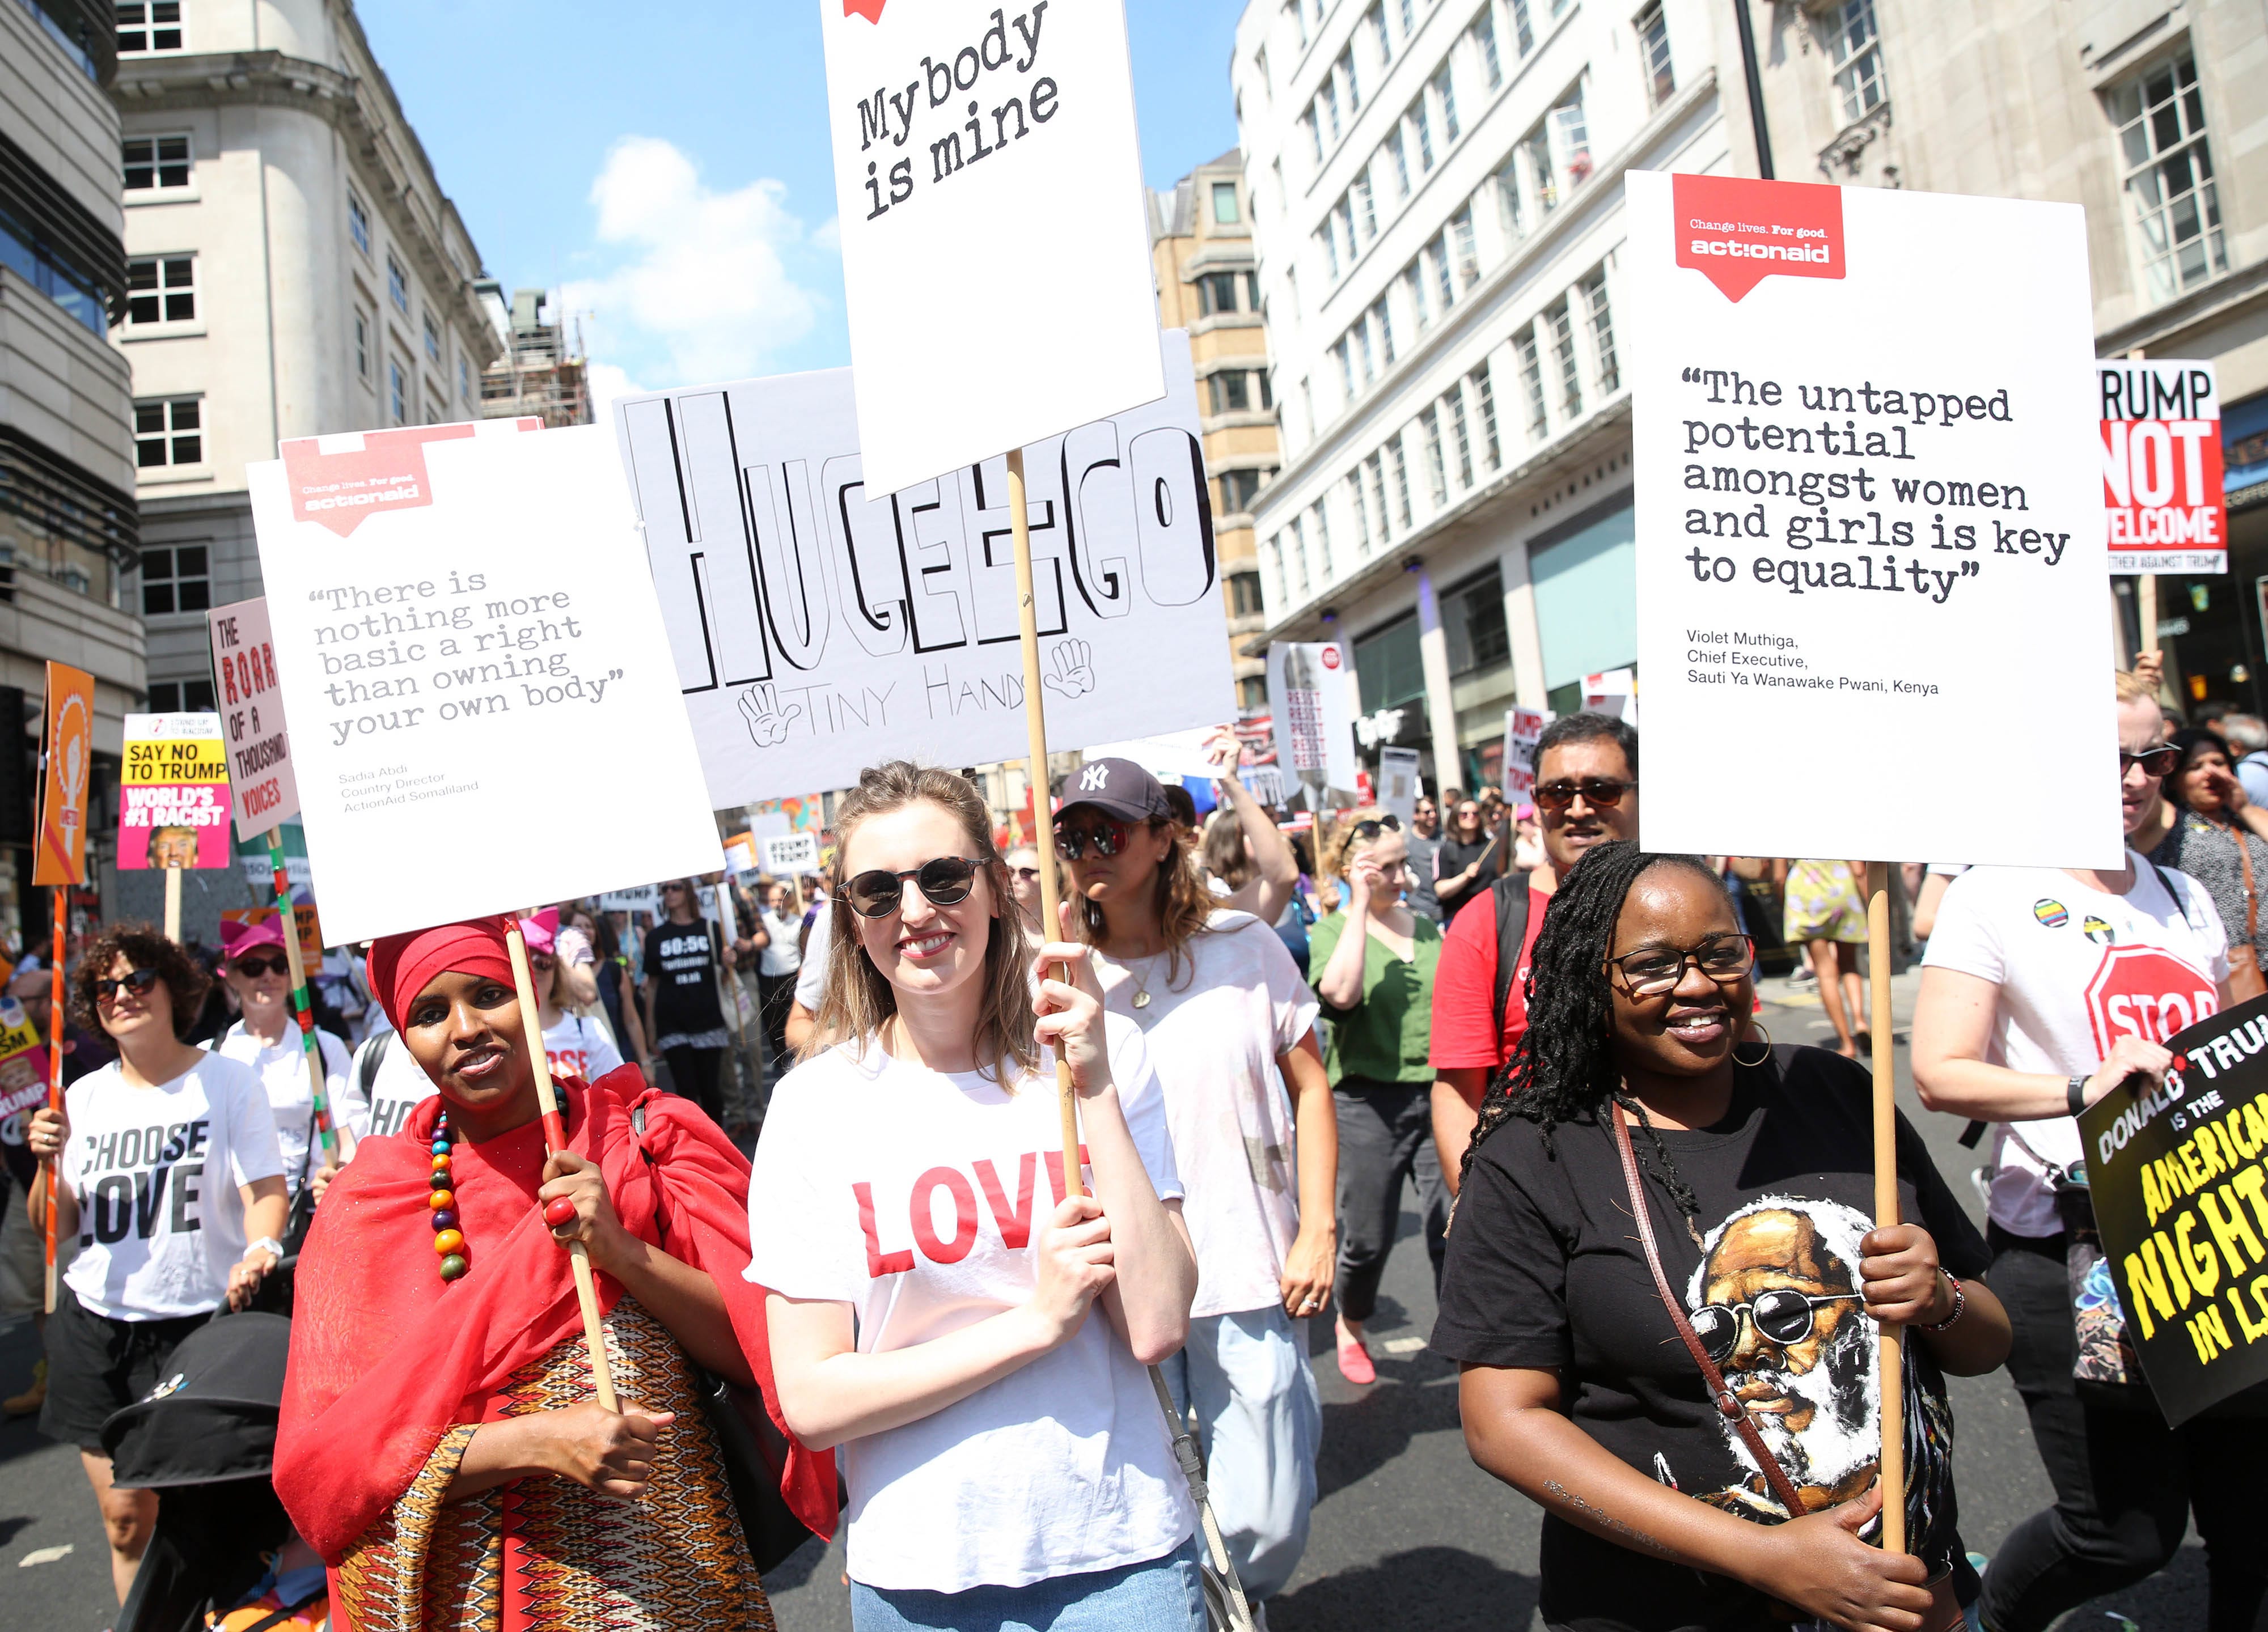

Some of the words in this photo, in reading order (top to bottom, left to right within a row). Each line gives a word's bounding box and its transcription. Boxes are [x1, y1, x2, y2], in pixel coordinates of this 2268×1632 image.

[857, 80, 919, 151] My
[920, 0, 1048, 109] body
[865, 156, 913, 221] is
[929, 77, 1059, 184] mine
[1690, 219, 1735, 233] Change
[1737, 222, 1768, 234] lives.
[1771, 224, 1794, 236] For
[1796, 228, 1829, 239] good.
[1798, 381, 2013, 427] untapped
[2101, 370, 2211, 419] RUMP
[1682, 416, 1915, 460] potential
[302, 483, 340, 494] Change
[369, 478, 388, 486] For
[390, 474, 416, 485] good.
[2101, 420, 2212, 508] NOT
[1684, 464, 1876, 505] amongst
[1892, 478, 2029, 511] women
[622, 390, 967, 695] HUGE
[1685, 503, 1770, 538] and
[1787, 507, 1914, 550] girls
[1931, 514, 1977, 550] is
[1992, 520, 2071, 566] key
[2106, 506, 2220, 545] ELCOME
[449, 570, 486, 595] is
[1685, 546, 1736, 583] to
[217, 616, 240, 650] THE
[314, 604, 473, 645] nothing
[485, 591, 570, 620] more
[1686, 629, 1729, 644] Violet
[1734, 632, 1798, 650] Muthiga,
[318, 640, 426, 675] basic
[439, 639, 462, 656] a
[473, 616, 582, 652] right
[1687, 649, 1727, 664] Chief
[1732, 652, 1808, 669] Executive,
[222, 642, 277, 706] ROAR
[323, 677, 420, 707] than
[433, 652, 570, 690] owning
[1688, 669, 1725, 684] Sauti
[1730, 672, 1749, 685] Ya
[1753, 673, 1834, 689] Wanawake
[1839, 677, 1888, 694] Pwani,
[1893, 680, 1939, 697] Kenya
[329, 706, 425, 747] your
[439, 694, 510, 720] own
[779, 681, 898, 736] TINY
[923, 662, 1025, 720] HAND
[230, 711, 246, 743] OF
[251, 706, 261, 735] A
[129, 763, 153, 780] TO
[159, 763, 226, 779] TRUMP
[130, 744, 165, 761] SAY
[171, 744, 198, 760] NO
[235, 732, 287, 781] THOUSAND
[339, 771, 375, 784] Sadia
[379, 765, 408, 778] Abdi
[241, 776, 282, 820] VOICES
[341, 783, 392, 799] Country
[395, 773, 445, 789] Director
[344, 794, 406, 813] ActionAid
[409, 781, 479, 801] Somaliland
[124, 807, 150, 827] #1
[151, 805, 225, 827] RACIST
[2098, 1068, 2185, 1165] DONALD
[2186, 1014, 2268, 1079] TRU
[2170, 1111, 2187, 1131] IS
[2186, 1089, 2224, 1118] THE
[81, 1121, 209, 1176] CHOOSE
[2123, 1156, 2268, 1342] NIGHT
[2185, 1303, 2234, 1366] IN
